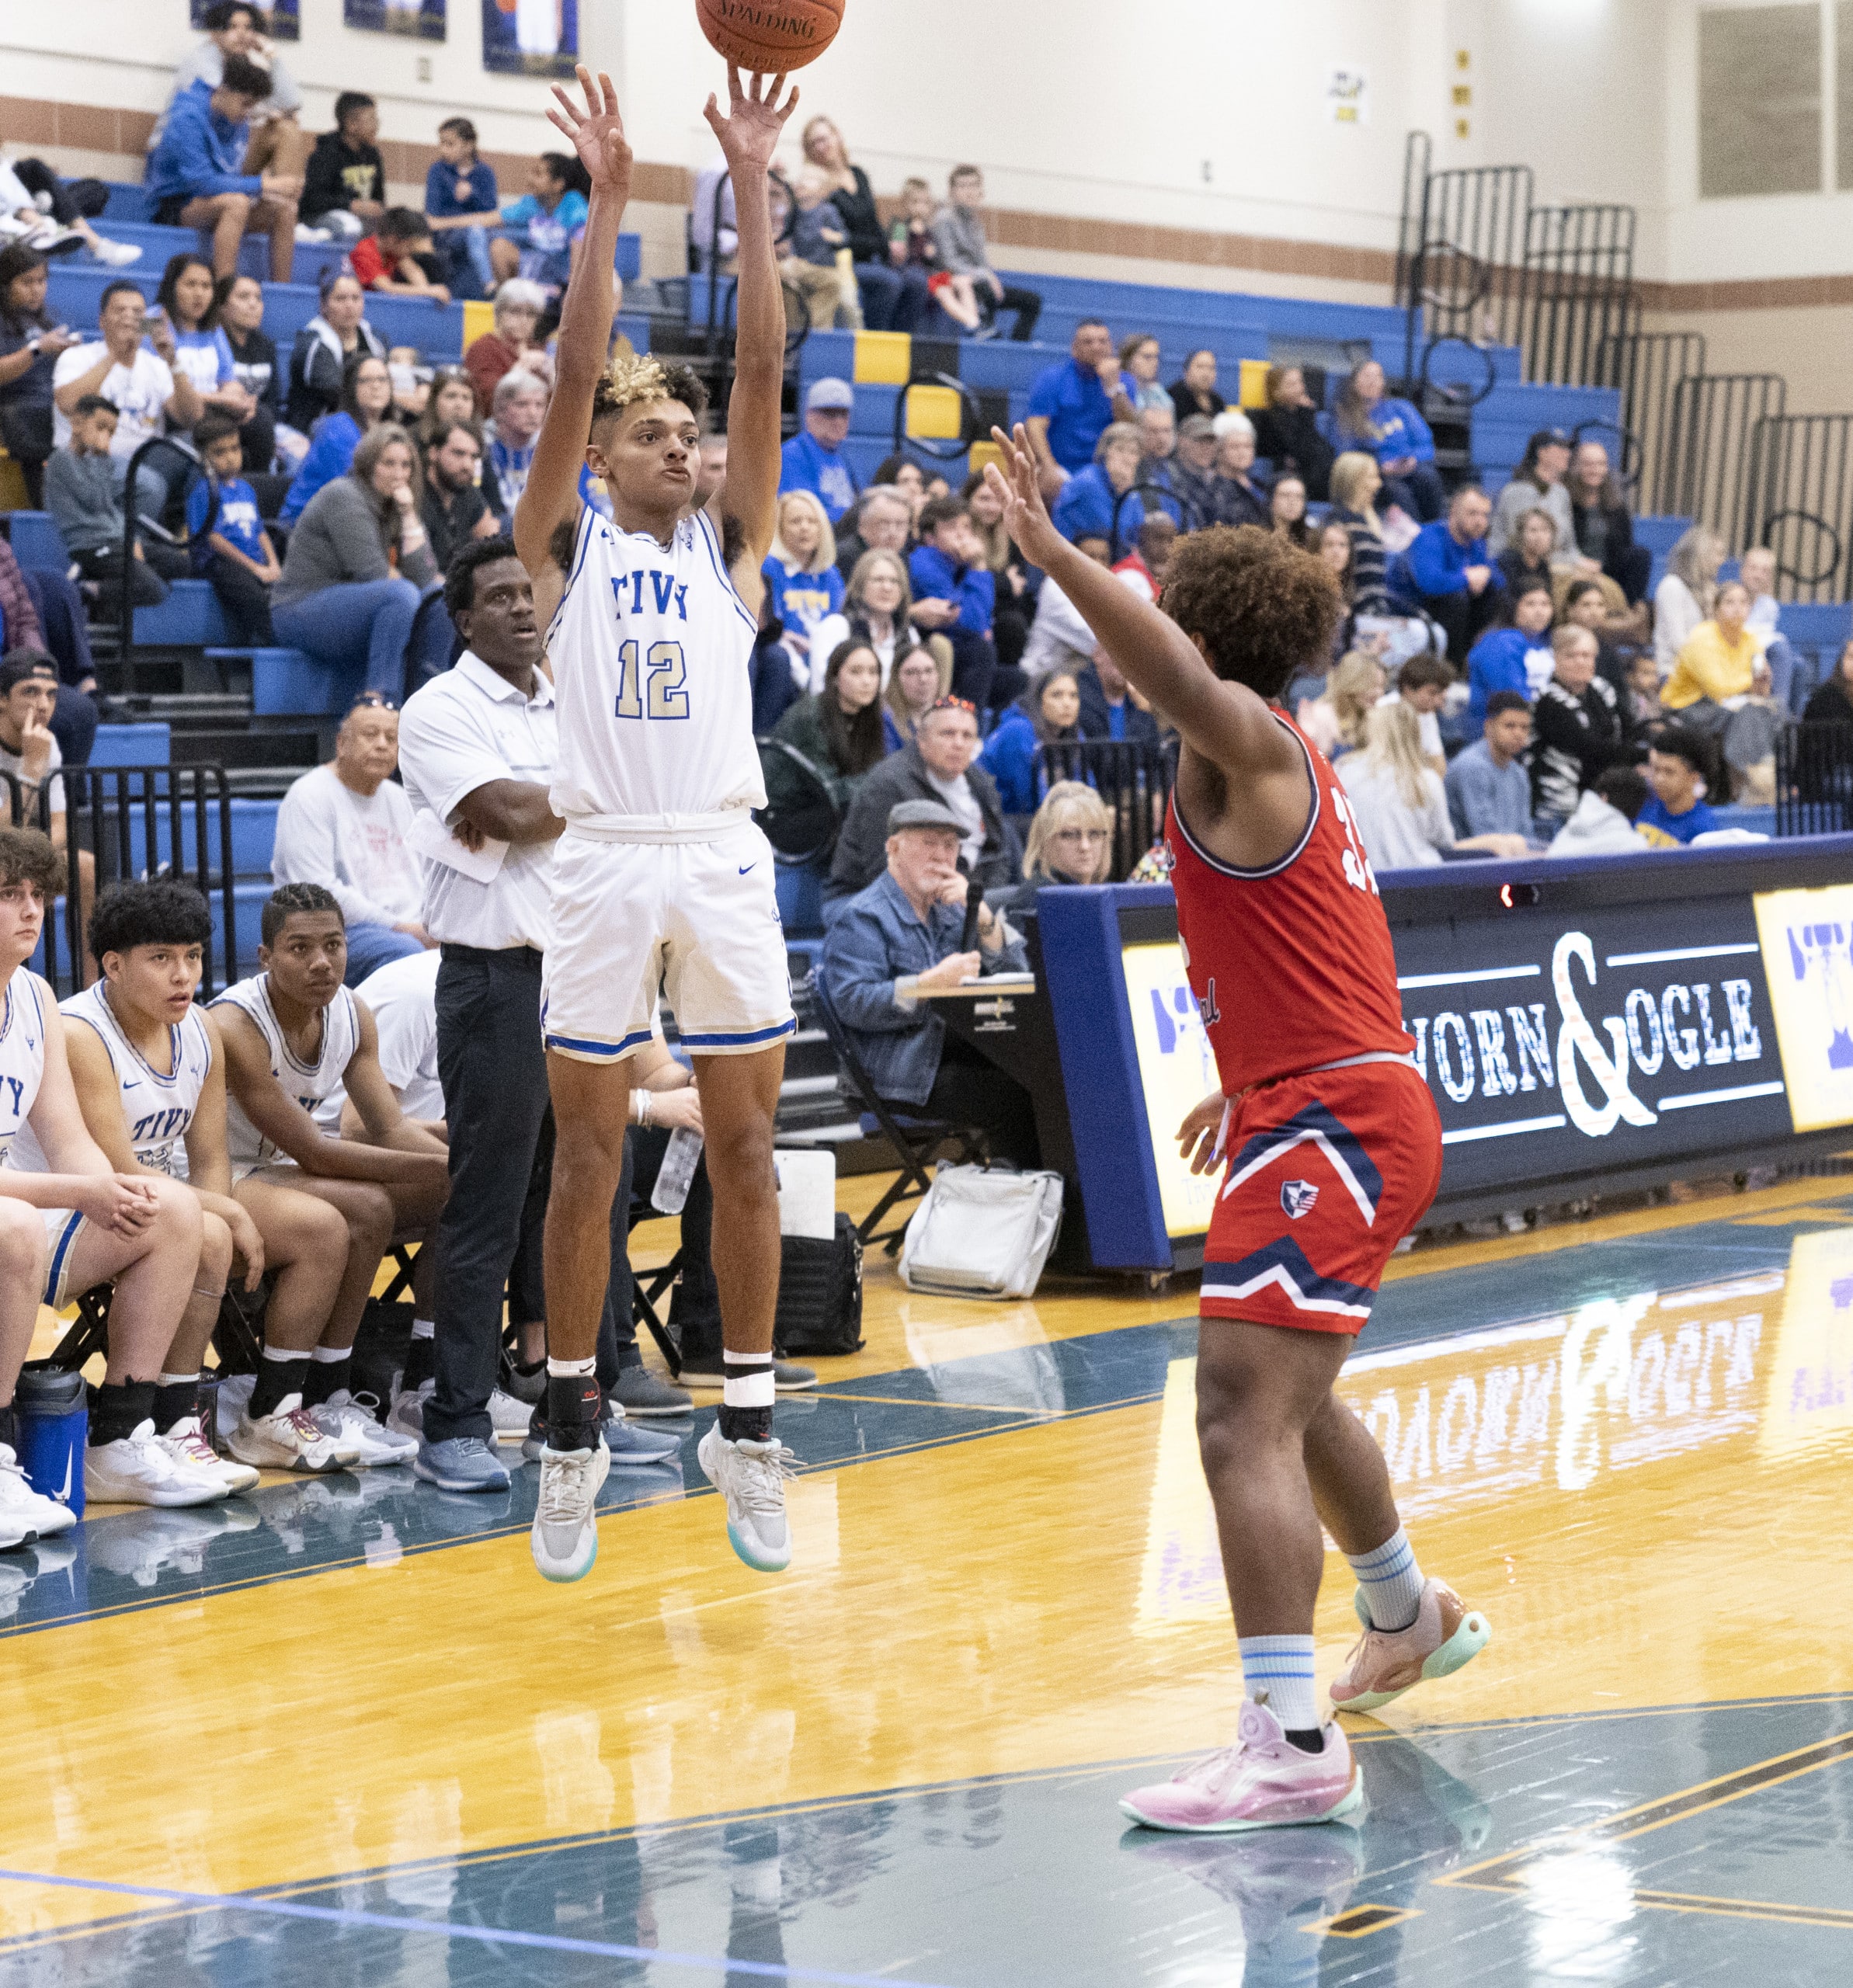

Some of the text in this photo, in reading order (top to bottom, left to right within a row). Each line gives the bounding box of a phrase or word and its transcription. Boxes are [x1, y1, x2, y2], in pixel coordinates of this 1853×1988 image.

[610, 570, 688, 621] TIVY
[615, 639, 690, 720] 12
[1625, 978, 1761, 1076] OGLE
[131, 1108, 191, 1142] TIVY
